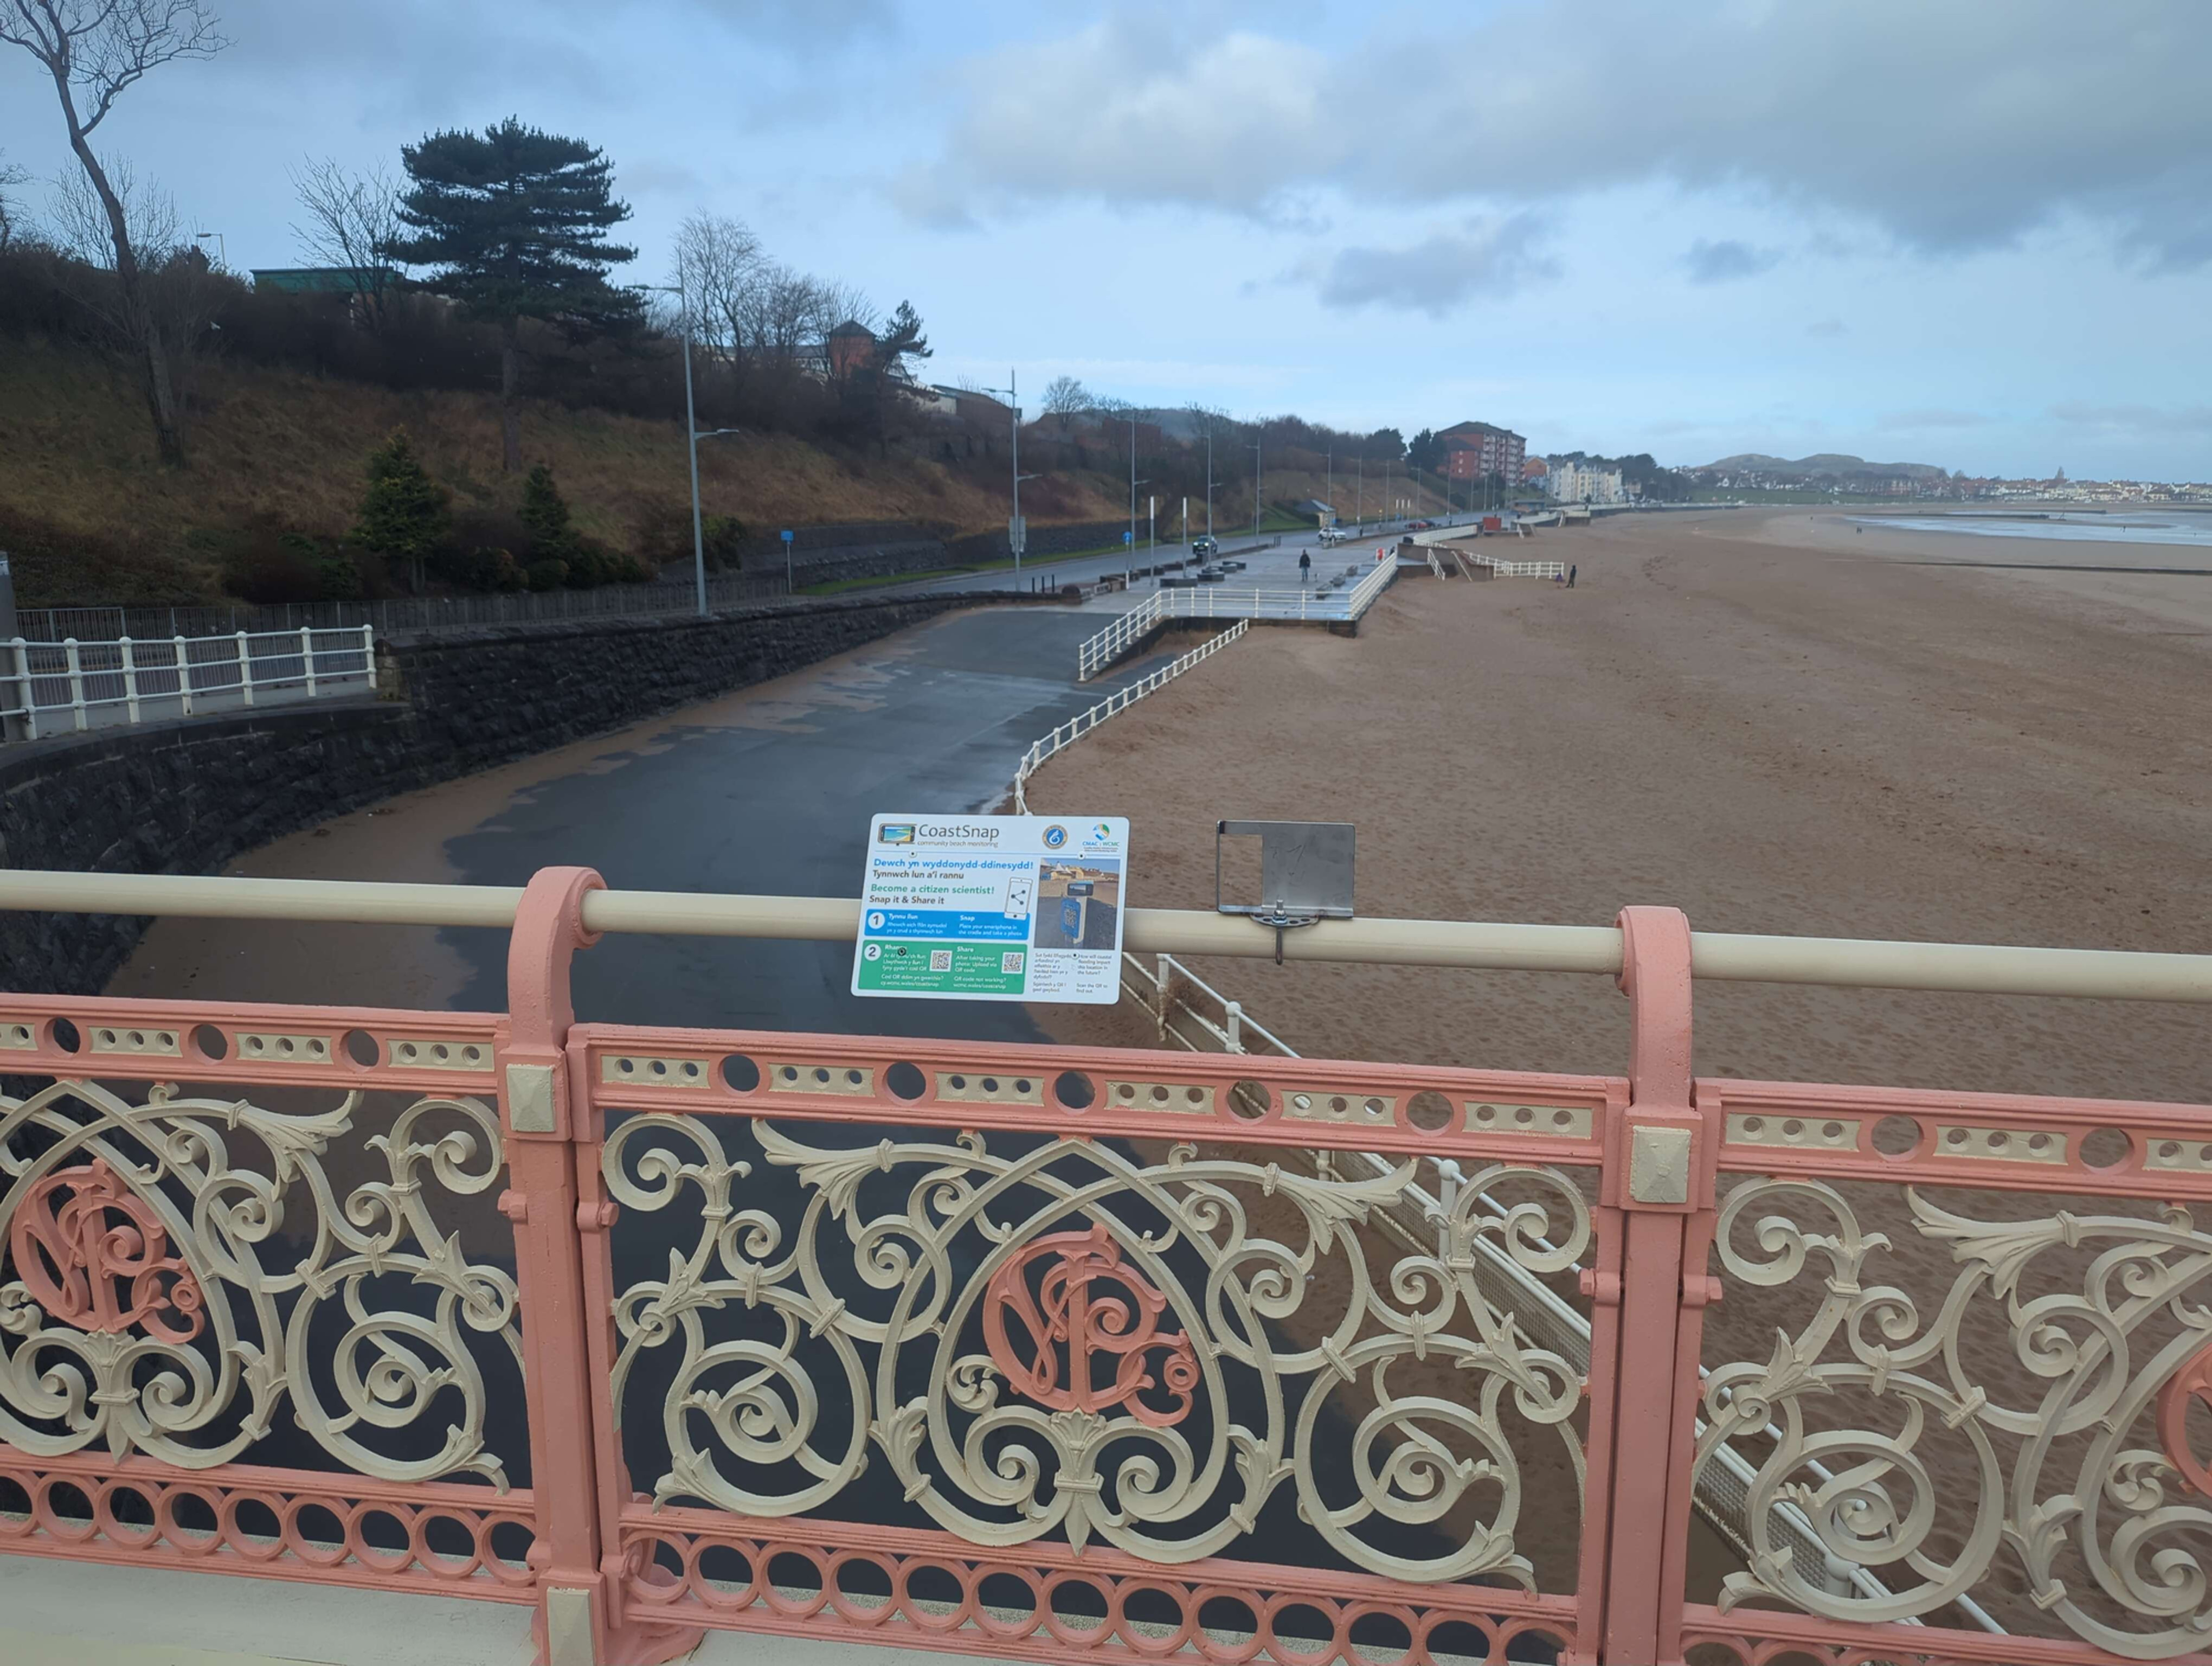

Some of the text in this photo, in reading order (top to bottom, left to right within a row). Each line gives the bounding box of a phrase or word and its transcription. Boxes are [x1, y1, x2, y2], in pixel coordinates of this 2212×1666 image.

[919, 824, 999, 840] CoastSnap
[874, 858, 905, 867] Dewch
[873, 869, 909, 879] Tynnwch
[871, 884, 908, 893] Become
[919, 885, 949, 894] citizen
[952, 886, 995, 894] scientist!
[869, 895, 890, 905] Snap
[872, 915, 879, 925] 1
[868, 946, 876, 957] 2
